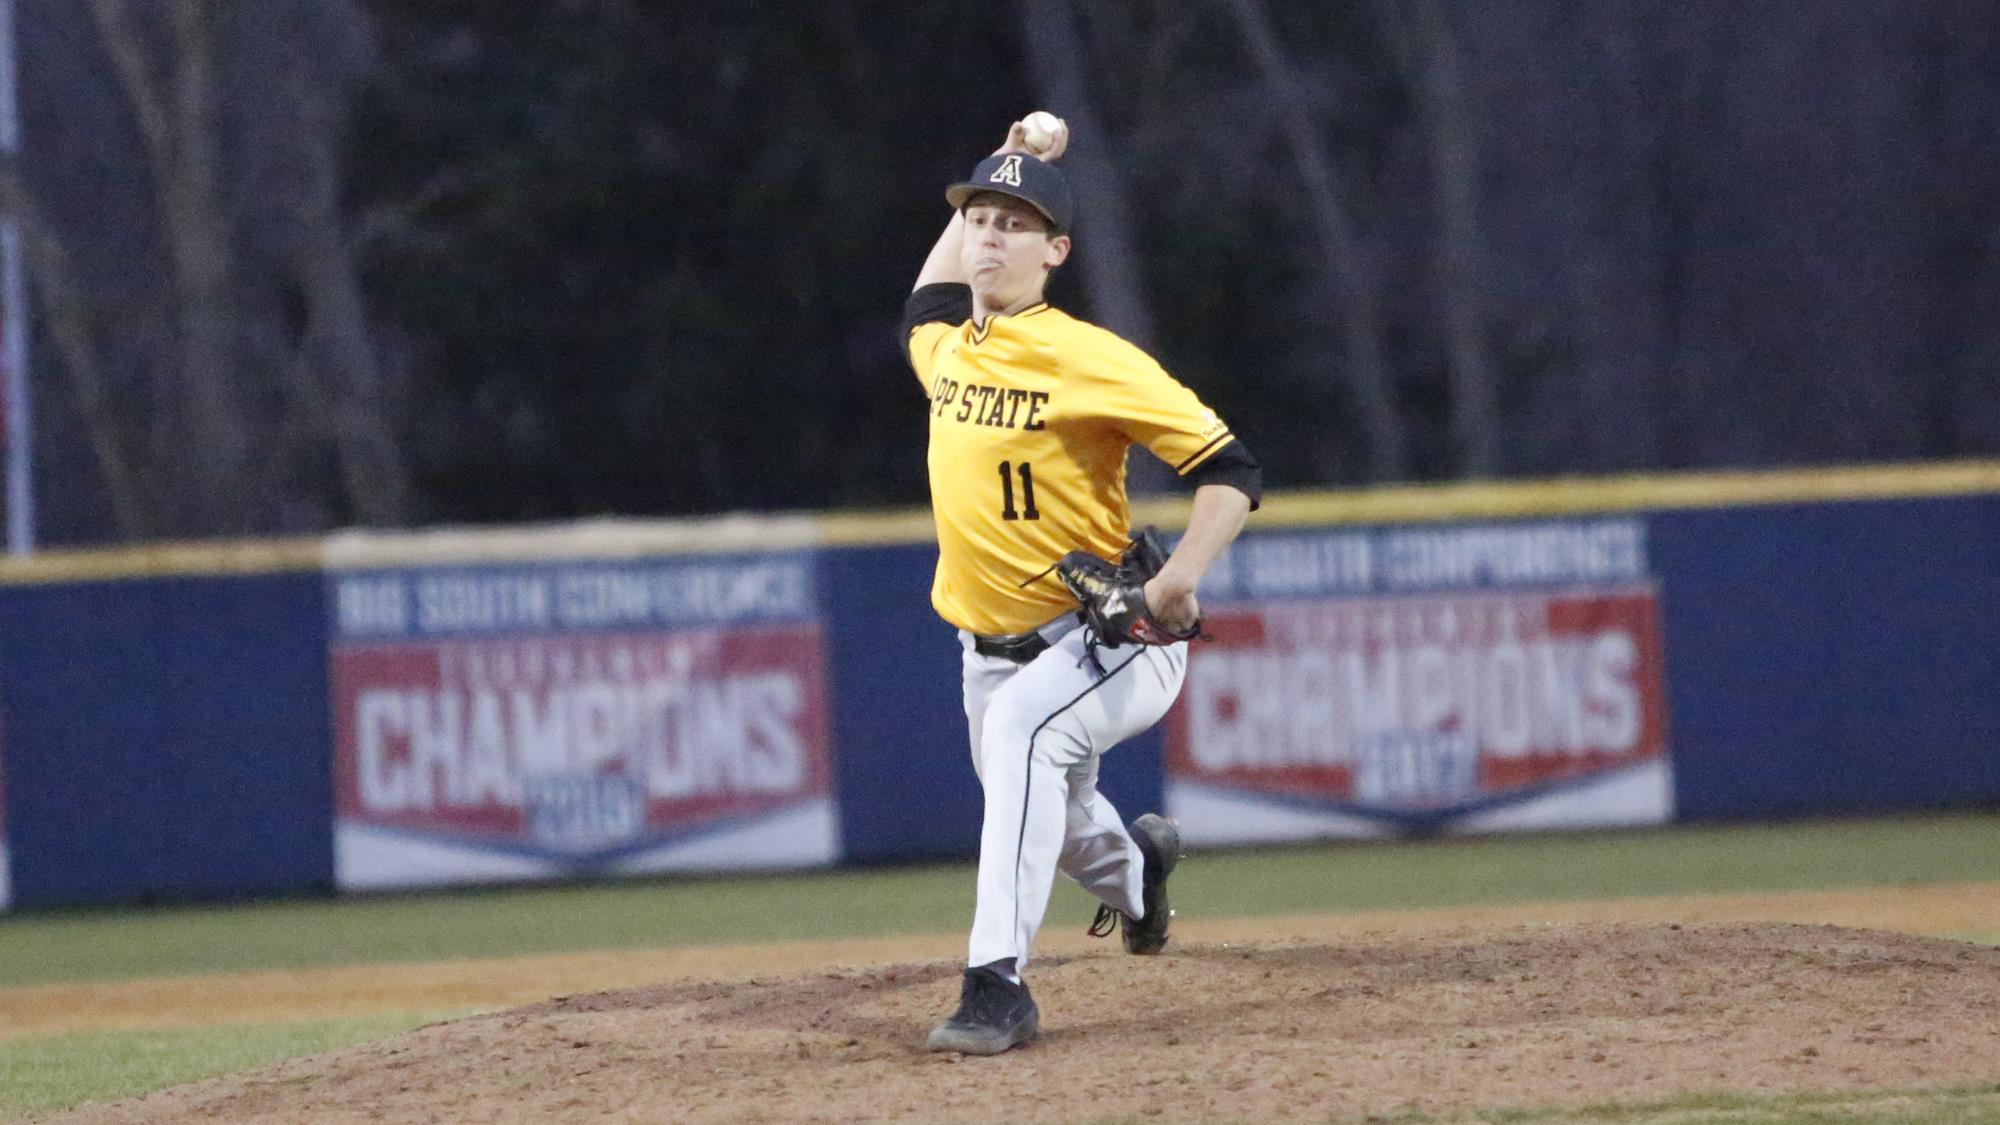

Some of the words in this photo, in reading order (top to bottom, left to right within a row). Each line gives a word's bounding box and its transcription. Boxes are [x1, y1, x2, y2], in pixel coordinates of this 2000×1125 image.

[990, 155, 1023, 187] A
[956, 384, 1050, 431] STATE
[998, 460, 1040, 521] 11
[417, 574, 549, 629] SOUTH
[1188, 631, 1643, 771] CHAMPIONS
[356, 671, 806, 811] CHAMPIONS
